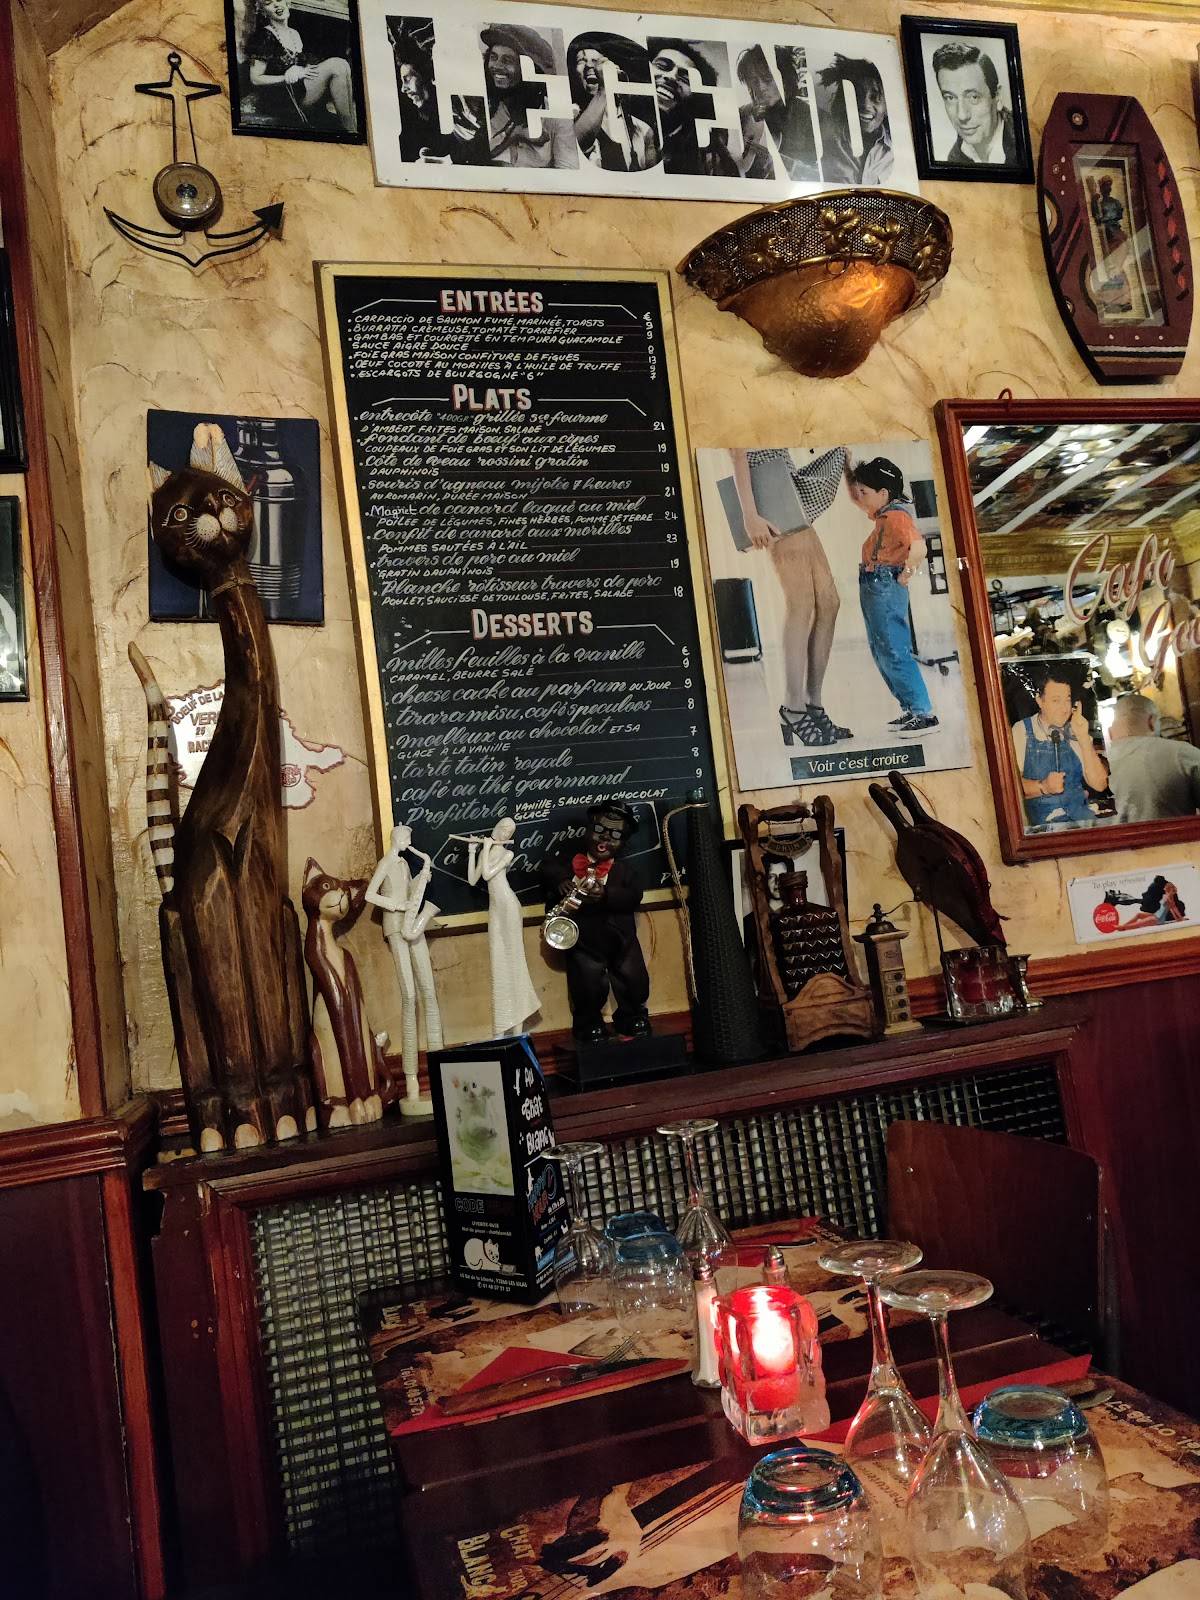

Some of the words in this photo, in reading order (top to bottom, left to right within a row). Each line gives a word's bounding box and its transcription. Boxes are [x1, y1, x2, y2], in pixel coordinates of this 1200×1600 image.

[385, 16, 894, 184] LEGEND
[440, 289, 544, 313] ENTRÉES
[355, 314, 414, 323] CARPACCIO
[437, 315, 481, 324] SAUMON
[354, 333, 403, 341] GAMBAS
[407, 334, 422, 342] ET
[424, 334, 481, 342] COURGETTE
[558, 336, 623, 345] GUACAMOLE
[520, 327, 578, 335] TORREFIER
[381, 351, 410, 359] GRAS
[358, 369, 421, 377] ESCARGOTS
[445, 370, 519, 380] BOURGOGNE
[578, 363, 622, 371] TRUFFE
[452, 383, 533, 411] PLATS
[360, 407, 432, 421] entrecôte
[546, 411, 608, 426] fourme
[360, 424, 416, 433] D'AMBERT
[418, 425, 456, 433] FRITES
[504, 425, 542, 433] SALADE
[653, 422, 665, 430] 21
[360, 433, 443, 446] fondant
[447, 433, 468, 443] de
[365, 445, 422, 453] COUPEAUX
[566, 442, 616, 453] LÉGUMES
[658, 444, 666, 452] 19
[370, 468, 439, 476] DAUPHINOIS
[661, 463, 670, 472] 19
[403, 454, 423, 466] de
[426, 455, 471, 466] veau
[478, 456, 532, 466] rossini
[535, 454, 589, 470] gratin
[368, 478, 421, 489] souris
[424, 478, 506, 493] d'agneau
[583, 477, 632, 489] heures
[442, 490, 480, 500] PURÉE
[665, 487, 675, 497] 21
[419, 504, 441, 515] de
[444, 502, 519, 514] canard
[523, 500, 576, 516] laqué
[579, 503, 604, 512] au
[606, 496, 646, 511] miel
[576, 515, 608, 523] POMME
[665, 512, 678, 520] 24
[434, 527, 457, 539] de
[460, 525, 527, 538] canard
[528, 526, 563, 537] aux
[565, 522, 632, 537] morilles
[378, 544, 427, 553] POMMES
[432, 540, 484, 551] SAUTÉES
[667, 534, 678, 543] 23
[376, 554, 439, 567] travers
[442, 553, 464, 565] de
[464, 554, 506, 569] porc
[508, 552, 534, 563] au
[537, 548, 580, 562] miel
[424, 567, 494, 576] DAUPHINOIS
[670, 559, 680, 569] 19
[381, 579, 461, 596] Planche
[469, 577, 538, 592] rôtisseur
[541, 575, 600, 590] travers
[604, 575, 621, 588] de
[427, 594, 479, 605] SAUCISSE
[595, 589, 634, 598] SALADE
[674, 586, 683, 597] 18
[472, 608, 594, 640] DESSERTS
[449, 646, 527, 672] feuilles
[548, 644, 570, 663] la
[452, 670, 498, 680] BEURRE
[682, 658, 690, 668] 9
[392, 684, 450, 704] cheese
[453, 679, 509, 700] cacke
[510, 687, 541, 698] au
[537, 679, 626, 702] parfum
[629, 683, 643, 691] DU
[643, 680, 672, 691] JOUR
[685, 678, 692, 688] 9
[171, 699, 197, 724] BOEUF
[198, 693, 212, 705] DE
[688, 698, 695, 709] 8
[396, 727, 496, 749] moelleux
[499, 730, 526, 741] au
[529, 716, 614, 738] chocolat
[610, 725, 624, 733] ET
[624, 724, 641, 732] SA
[398, 748, 436, 759] GLACE
[452, 745, 466, 754] LA
[690, 726, 697, 736] 7
[402, 757, 450, 778] tarte
[455, 754, 508, 775] tatin
[513, 748, 573, 775] royale
[692, 747, 699, 757] 8
[808, 760, 835, 773] Voir
[839, 758, 868, 770] c'est
[872, 754, 909, 766] croire
[400, 780, 451, 805] café
[452, 784, 476, 797] ou
[478, 774, 514, 795] thé
[516, 766, 632, 797] gourmand
[696, 768, 702, 778] 9
[558, 795, 591, 806] SAUCE
[612, 788, 669, 798] CHOCOLAT
[514, 809, 551, 820] GLACE
[500, 1524, 535, 1560] CHAT
[457, 1532, 497, 1586] BLANC
